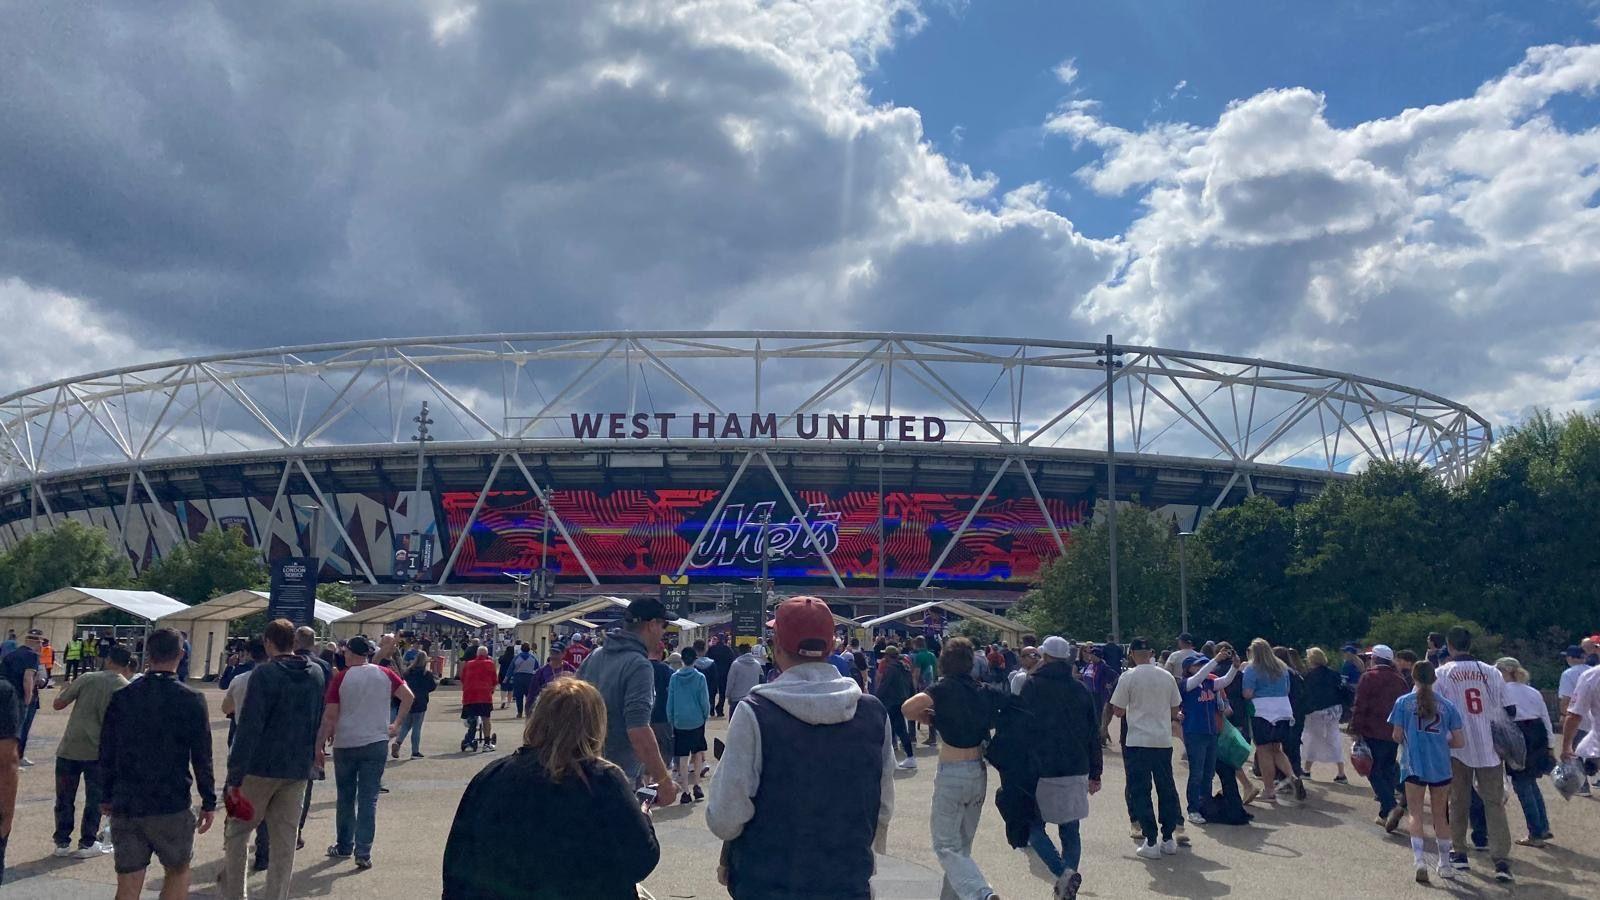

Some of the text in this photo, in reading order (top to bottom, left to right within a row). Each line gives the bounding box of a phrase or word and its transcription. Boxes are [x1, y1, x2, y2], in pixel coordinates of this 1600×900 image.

[570, 413, 947, 442] WEST HAM UNITED
[690, 501, 841, 569] Mets
[409, 557, 415, 568] 1
[573, 654, 582, 664] 10
[1465, 688, 1483, 714] 6
